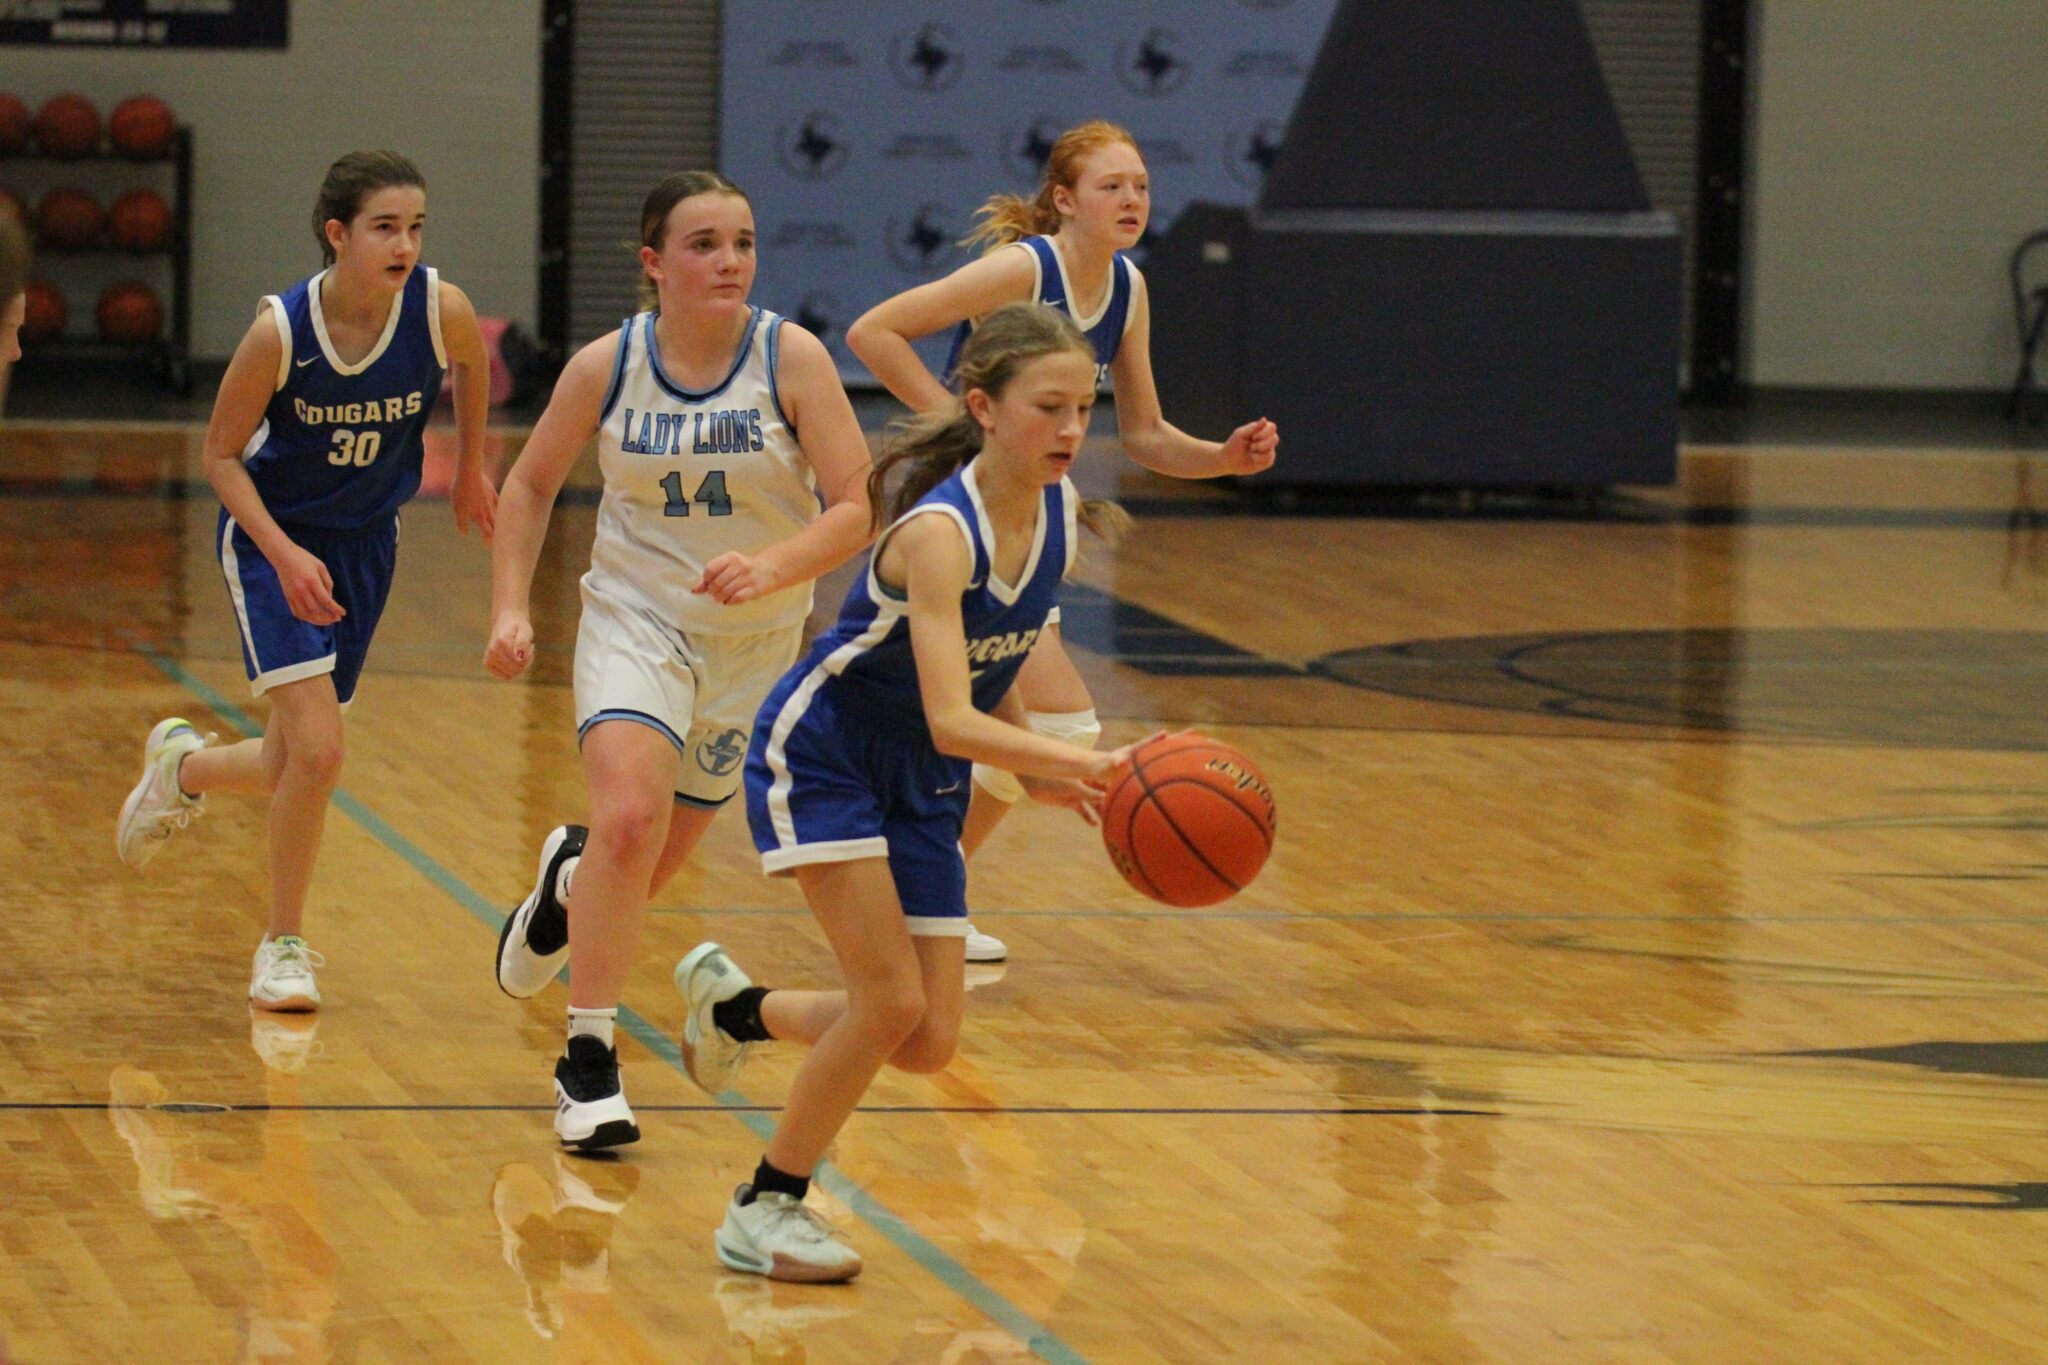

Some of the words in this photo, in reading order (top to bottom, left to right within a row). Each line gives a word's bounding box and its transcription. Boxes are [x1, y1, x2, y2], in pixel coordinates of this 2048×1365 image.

[294, 391, 422, 425] COUGARS
[328, 429, 381, 467] 30
[622, 408, 687, 455] LADY
[693, 408, 764, 454] LIONS
[659, 471, 732, 517] 14
